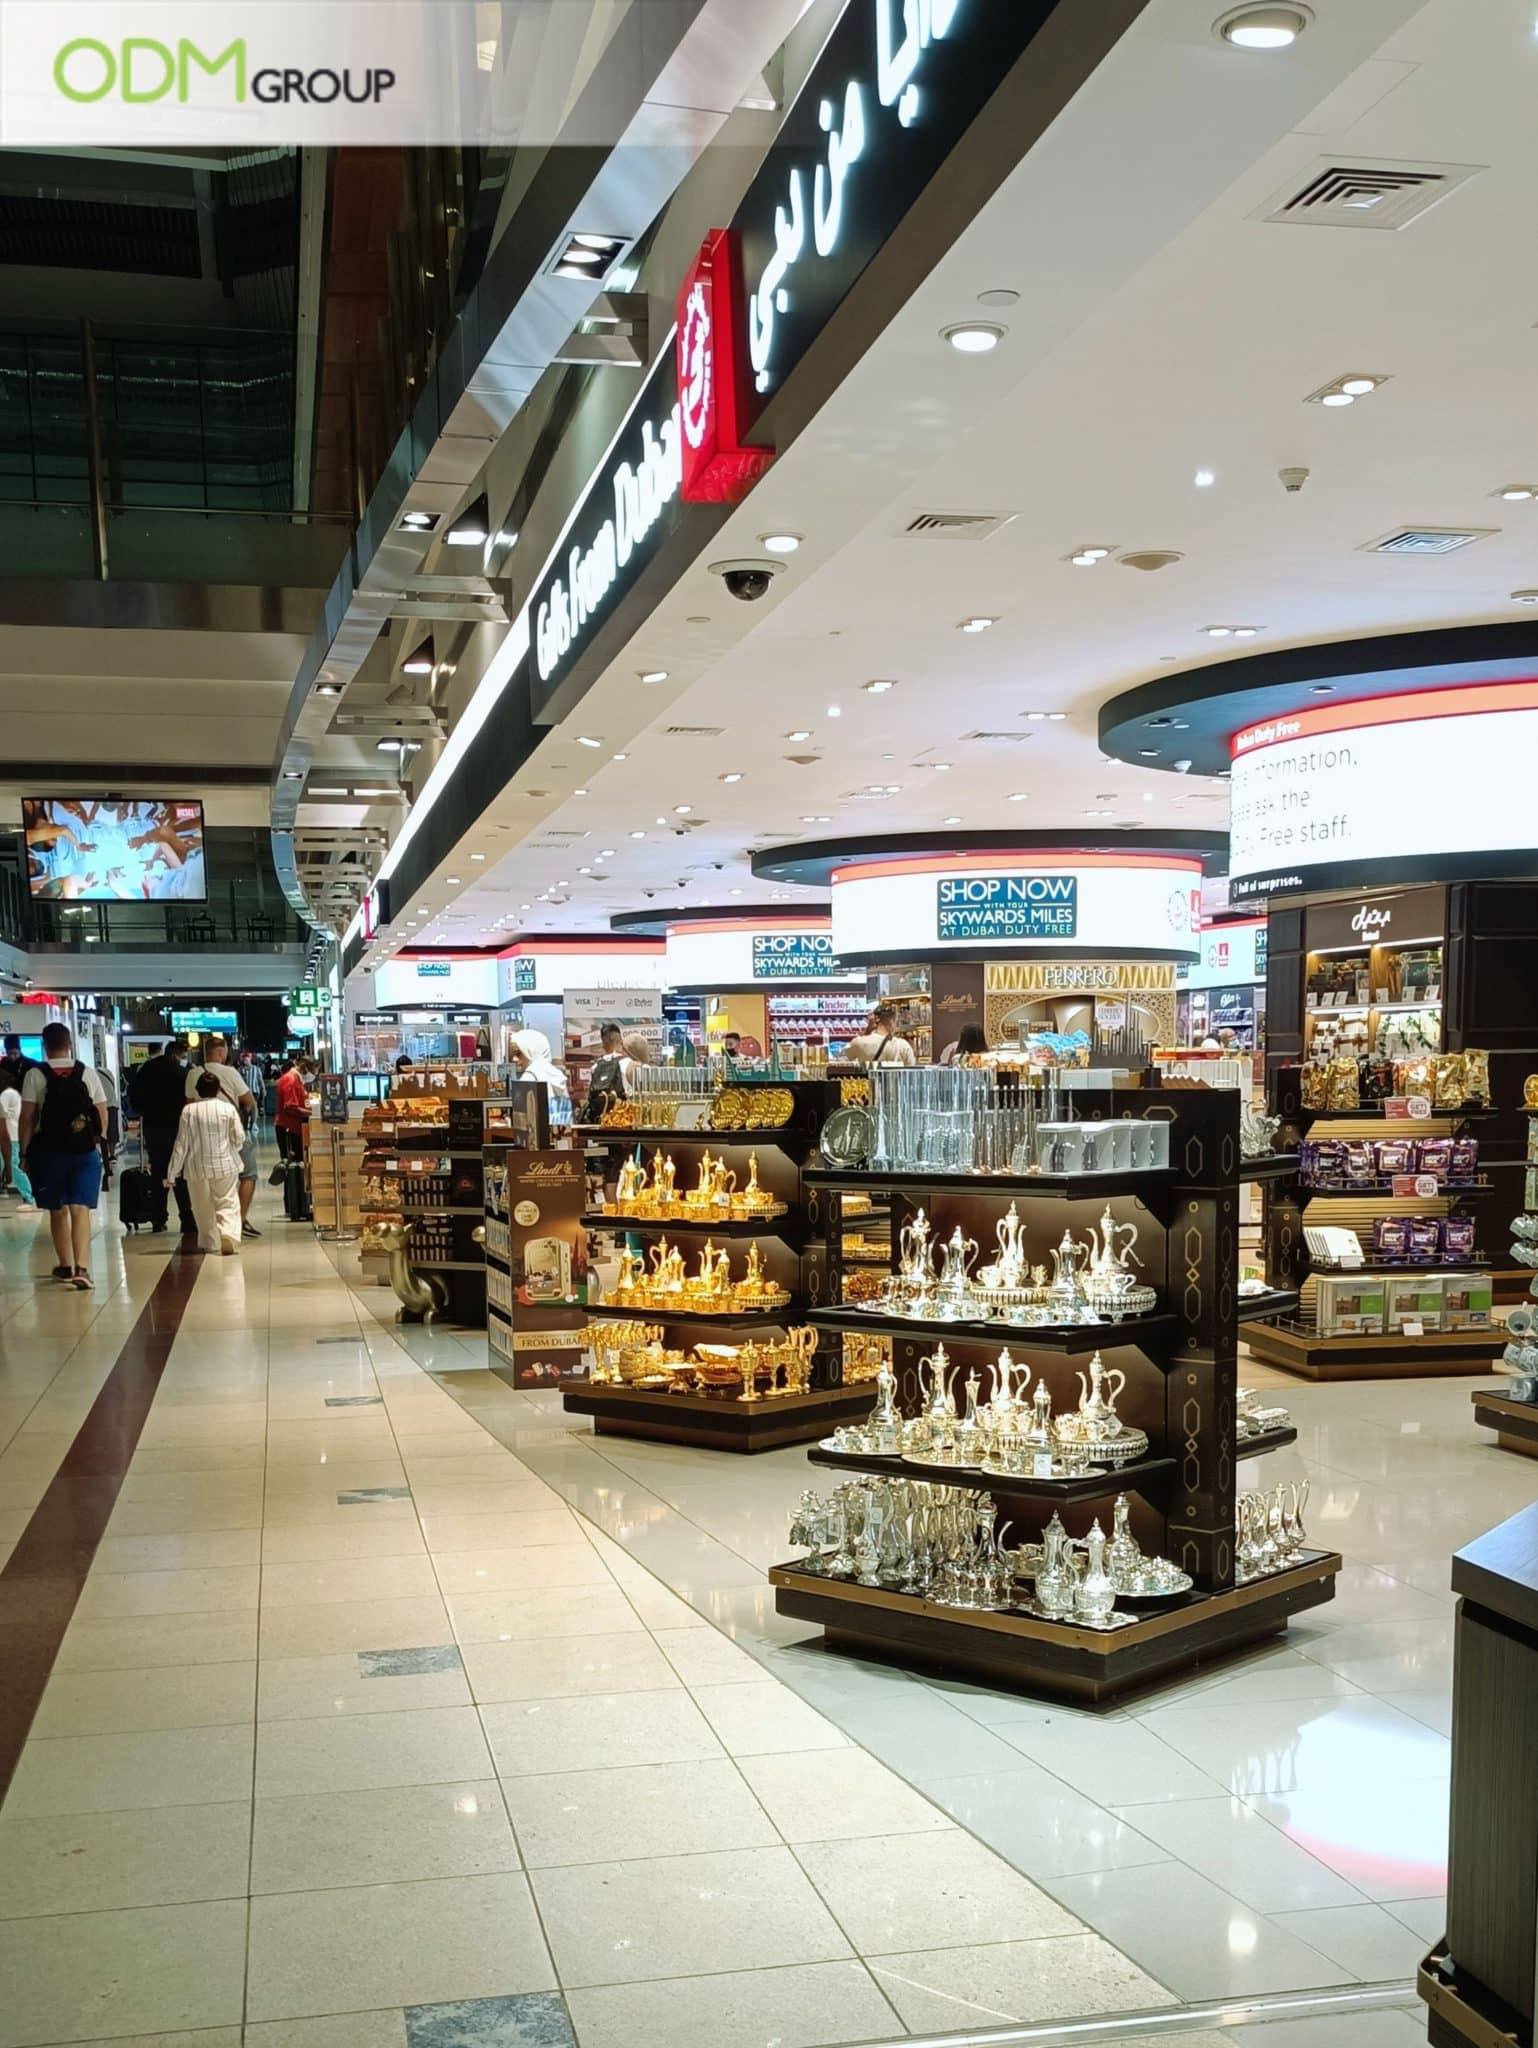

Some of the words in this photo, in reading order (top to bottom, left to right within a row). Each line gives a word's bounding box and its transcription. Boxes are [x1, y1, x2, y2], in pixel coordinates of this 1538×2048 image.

[569, 545, 617, 639] From
[941, 880, 1000, 902] SHOP
[1007, 878, 1074, 900] NOW
[940, 909, 1026, 926] SKYWARDS
[1030, 908, 1073, 923] MILES
[941, 926, 957, 937] AT
[961, 925, 1000, 936] DUBAI
[1005, 924, 1039, 935] DUTY
[1044, 924, 1072, 934] FREE
[754, 936, 798, 952] SHOP
[754, 957, 815, 968] SKYWARDS
[817, 957, 834, 968] MIL
[756, 968, 767, 976] AT
[770, 968, 797, 976] DUBAI
[800, 968, 825, 976] DUTY
[1043, 967, 1118, 986] FERRERO
[521, 1338, 550, 1348] FROM
